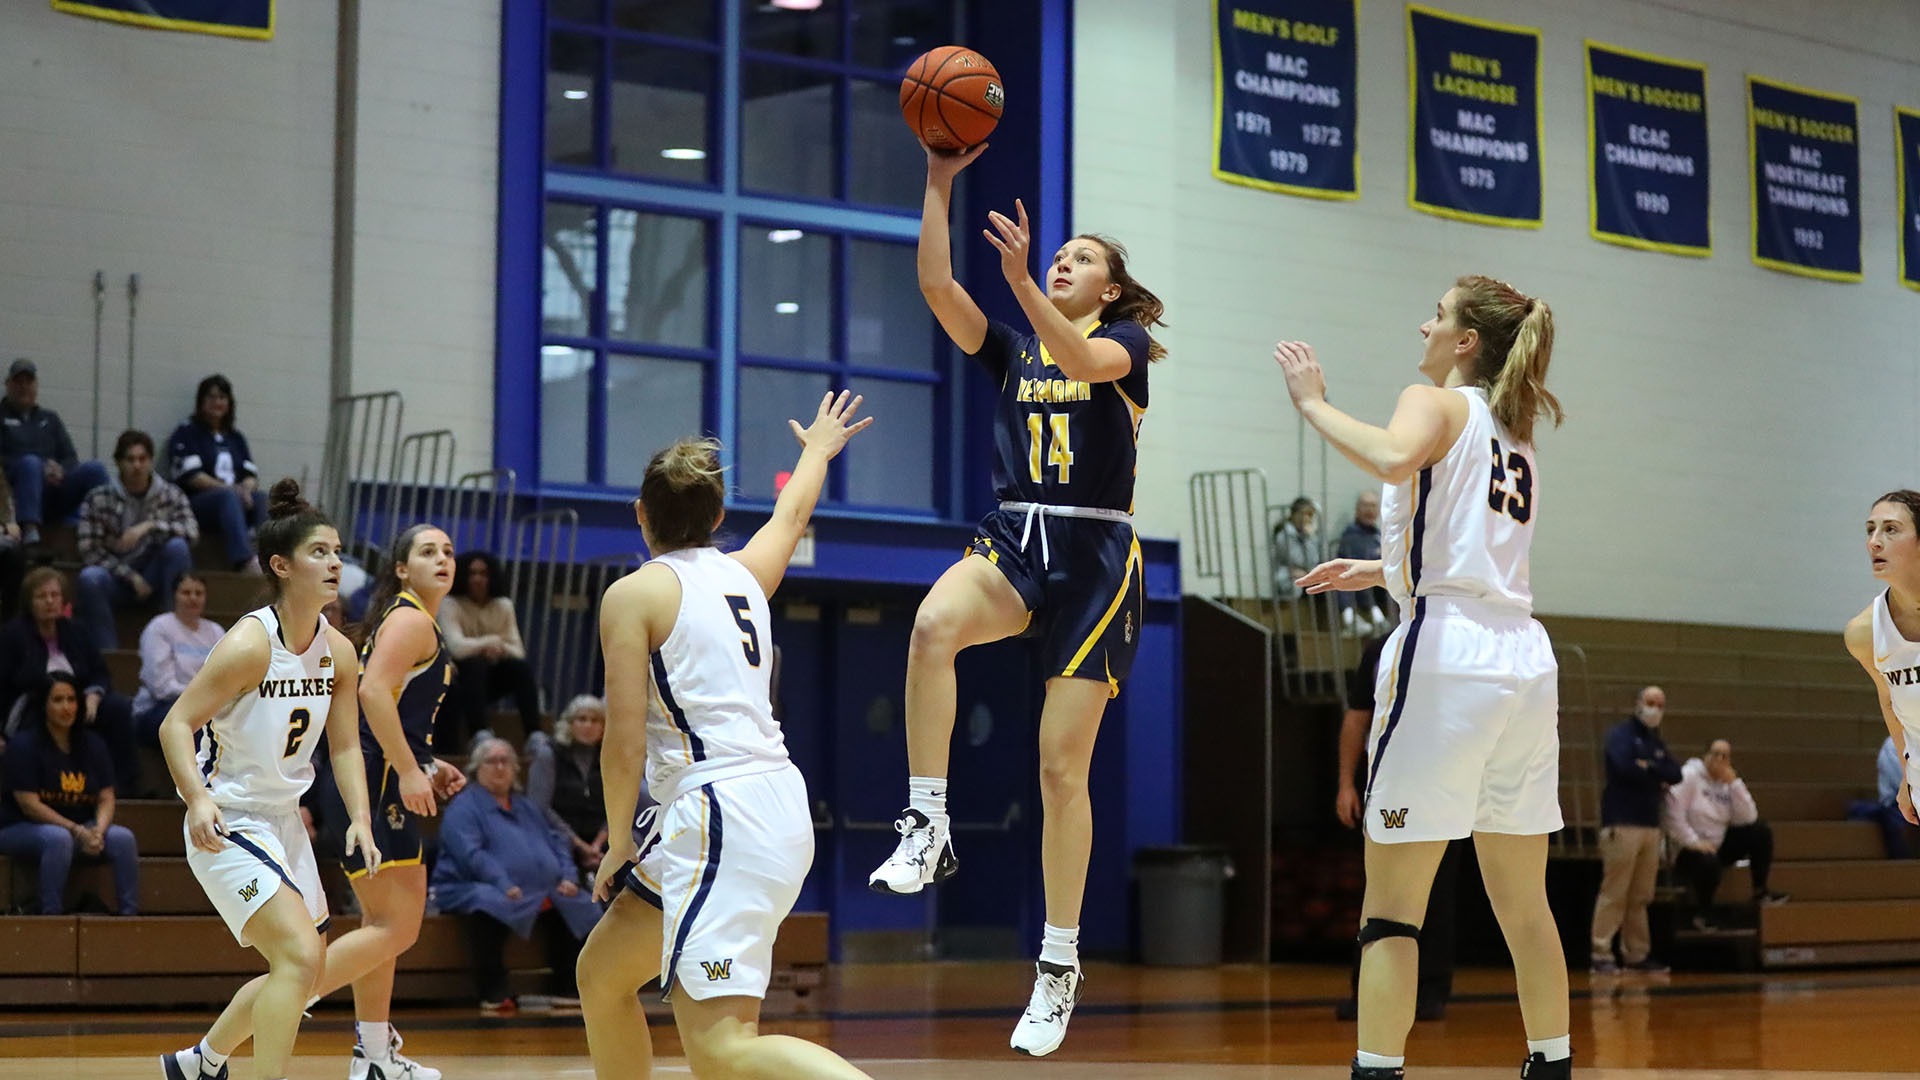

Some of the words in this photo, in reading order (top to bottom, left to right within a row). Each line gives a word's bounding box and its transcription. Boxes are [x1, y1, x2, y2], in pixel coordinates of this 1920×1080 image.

[1233, 9, 1290, 39] MEN'S
[1293, 22, 1339, 46] GOLF
[1266, 52, 1308, 78] MAC
[1450, 52, 1501, 79] MEN'S
[1235, 70, 1340, 107] CHAMPIONS
[1433, 73, 1518, 105] LACROSSE
[1593, 75, 1641, 102] MEN'S
[1644, 87, 1701, 112] SOCCER
[1235, 111, 1271, 137] 1971
[1302, 124, 1342, 147] 1972
[1457, 110, 1496, 134] MAC
[1628, 124, 1670, 149] ECAC
[1754, 108, 1798, 134] MEN'S
[1800, 119, 1854, 144] SOCCER
[1430, 128, 1529, 162] CHAMPIONS
[1605, 143, 1694, 176] CHAMPIONS
[1789, 146, 1822, 168] MAC
[1269, 150, 1308, 173] 1979
[1459, 166, 1496, 189] 1975
[1765, 163, 1847, 193] NORTHEAST
[1767, 185, 1849, 216] CHAMPIONS
[1027, 412, 1074, 484] 14
[1488, 437, 1533, 526] 23
[724, 594, 762, 668] 5
[259, 678, 334, 698] WILKES
[283, 707, 310, 758] 2
